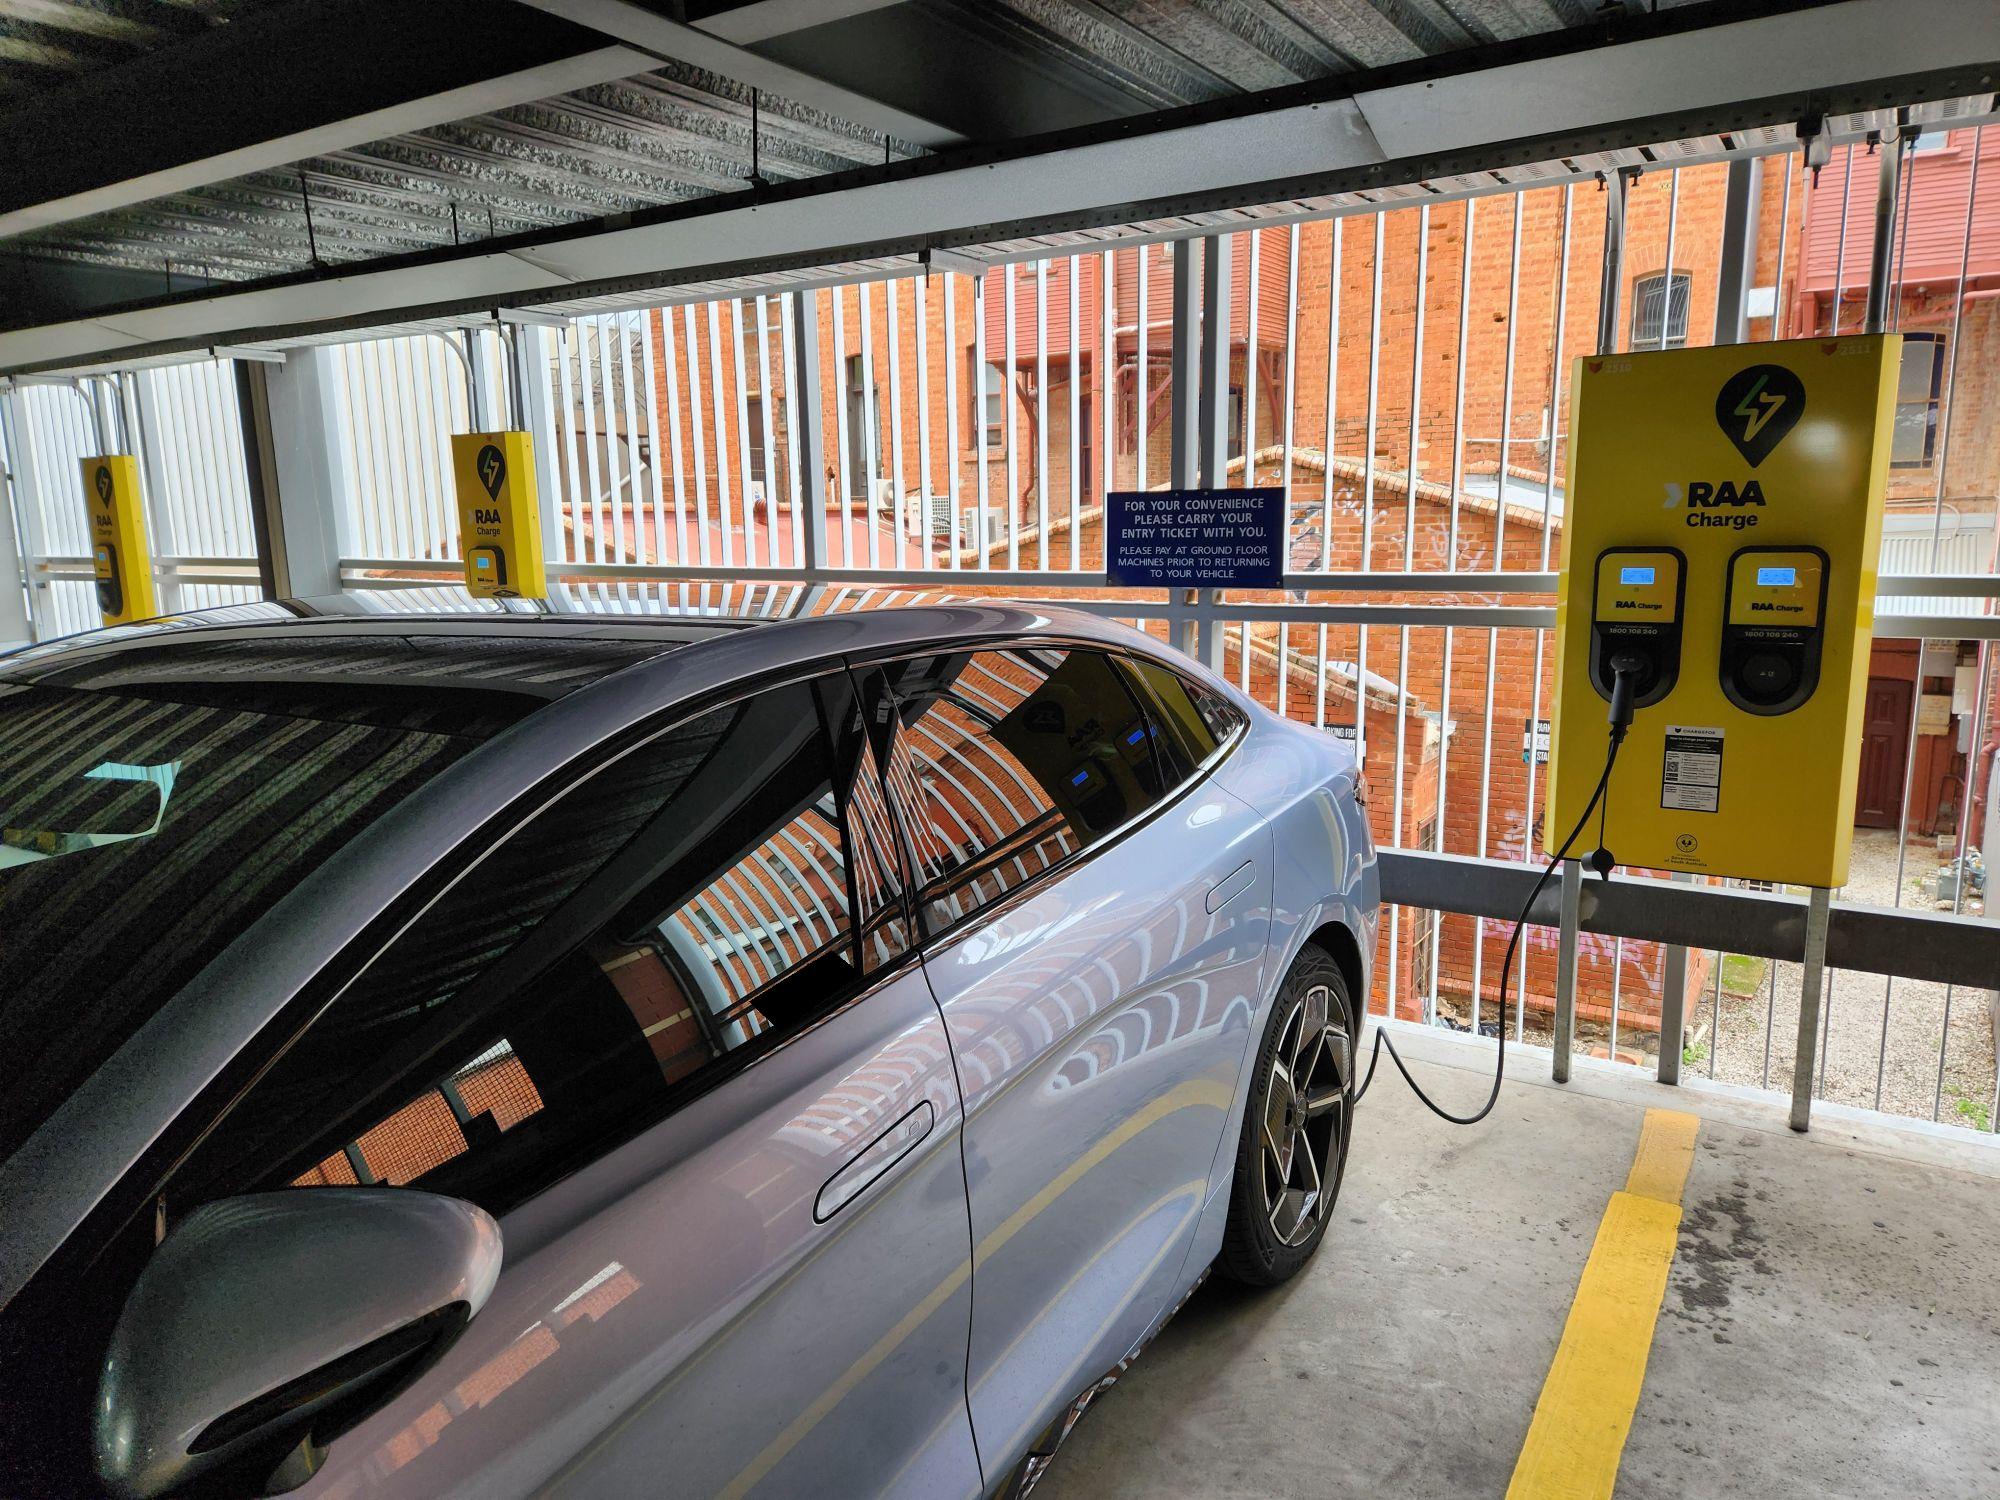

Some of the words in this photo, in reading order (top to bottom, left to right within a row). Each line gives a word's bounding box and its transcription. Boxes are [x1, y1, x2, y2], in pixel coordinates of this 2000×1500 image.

[1840, 344, 1871, 356] 2511
[1687, 480, 1767, 508] RAA
[1125, 501, 1145, 512] FOR
[1150, 500, 1180, 511] YOUR
[1185, 498, 1264, 510] CONVENIENCE
[475, 509, 502, 525] RAA
[1134, 514, 1173, 525] PLEASE
[1177, 513, 1216, 524] CARRY
[1221, 513, 1253, 523] YOUR
[1686, 511, 1759, 531] Charge
[476, 527, 501, 537] Charge
[1121, 528, 1156, 539] ENTRY
[1160, 528, 1198, 538] TICKET
[1203, 527, 1234, 538] WITH
[1239, 526, 1267, 537] YOU.
[1119, 546, 1152, 555] PLEASE
[1155, 546, 1172, 555] PAY
[1175, 546, 1188, 555] AT
[1190, 546, 1233, 555] GROUND
[1236, 545, 1268, 554] FLOOR
[1118, 558, 1164, 567] MACHINES
[1167, 558, 1195, 567] PRIOR
[1199, 558, 1212, 567] TO
[1215, 557, 1271, 567] RETURNING
[1150, 569, 1163, 578] TO
[1167, 569, 1192, 578] YOUR
[1196, 569, 1237, 579] VEHICLE.
[1615, 600, 1637, 609] RAA
[1637, 602, 1663, 611] Charge
[1751, 602, 1774, 611] RAA
[1775, 604, 1804, 612] Charge
[1257, 1008, 1286, 1096] Continental
